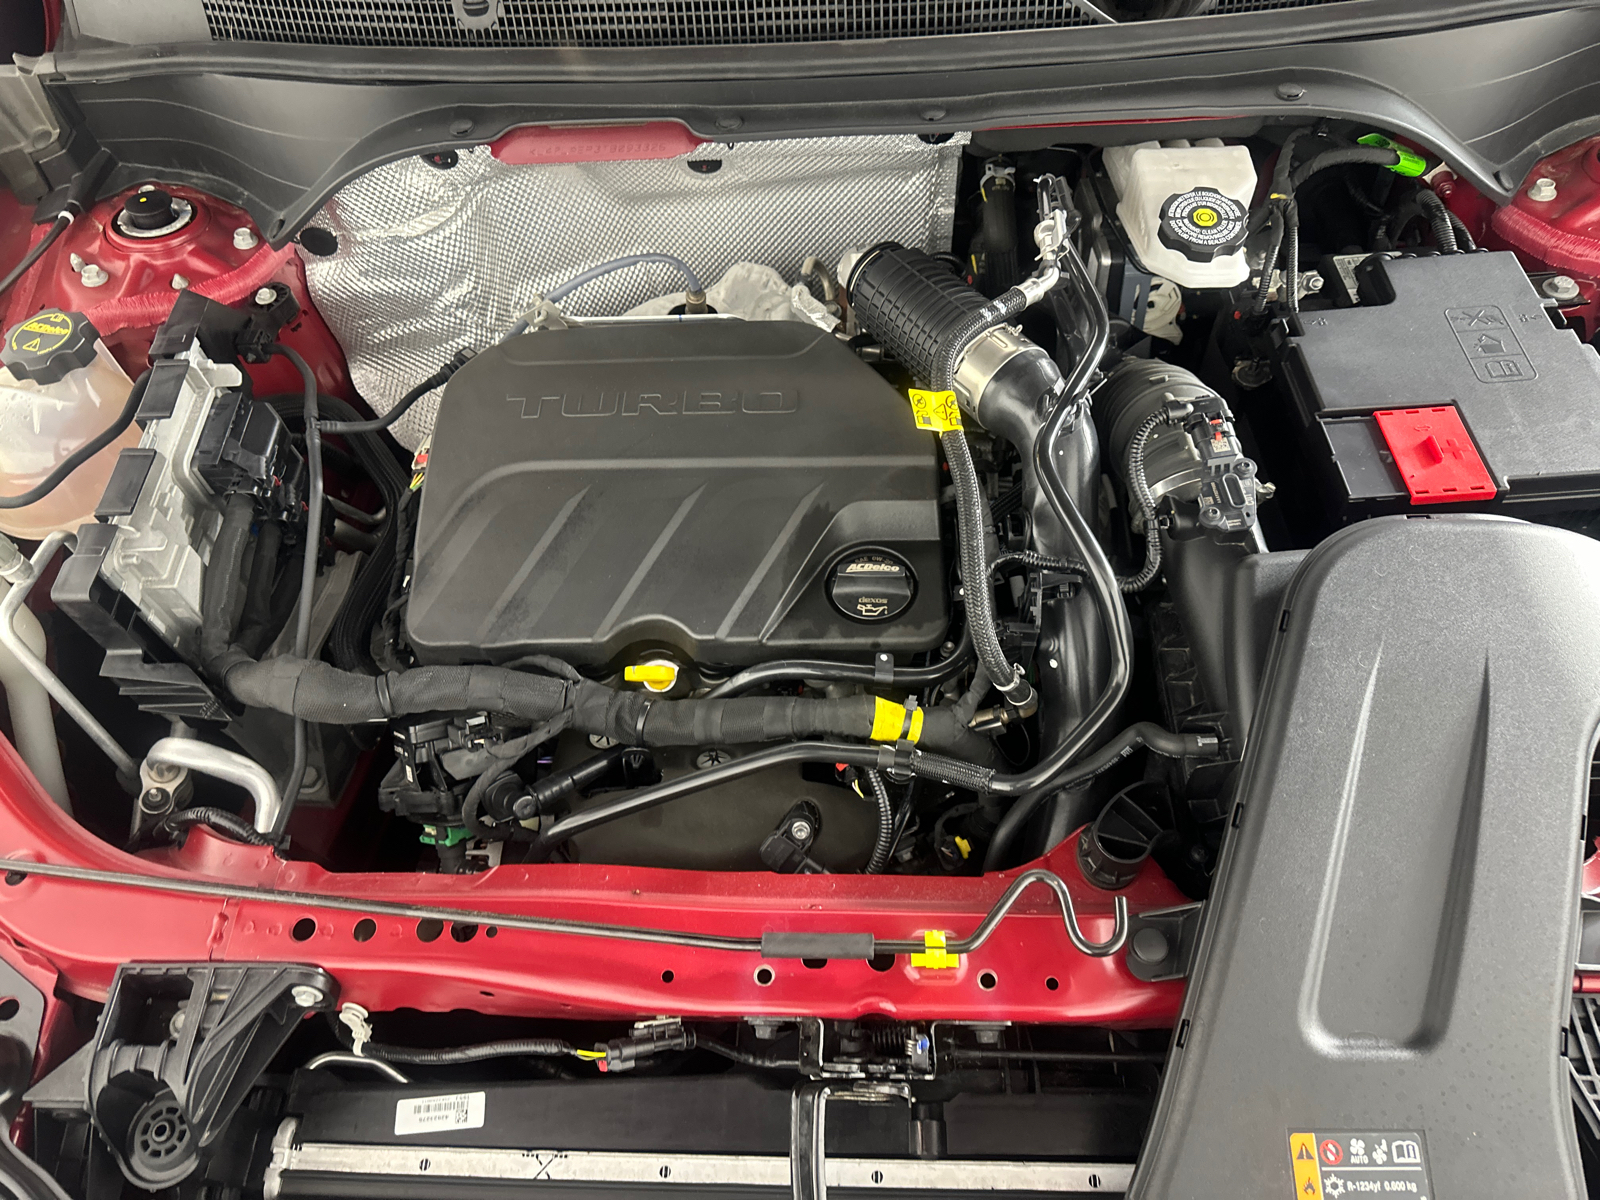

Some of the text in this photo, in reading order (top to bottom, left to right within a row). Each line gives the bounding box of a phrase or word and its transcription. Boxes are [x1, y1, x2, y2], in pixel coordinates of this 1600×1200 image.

[506, 390, 798, 419] TURBO
[845, 563, 900, 573] ACDelco
[858, 596, 888, 604] dexos
[1350, 1155, 1369, 1164] AUTO
[1346, 1180, 1381, 1193] R-1234yf
[1406, 1181, 1417, 1193] kg
